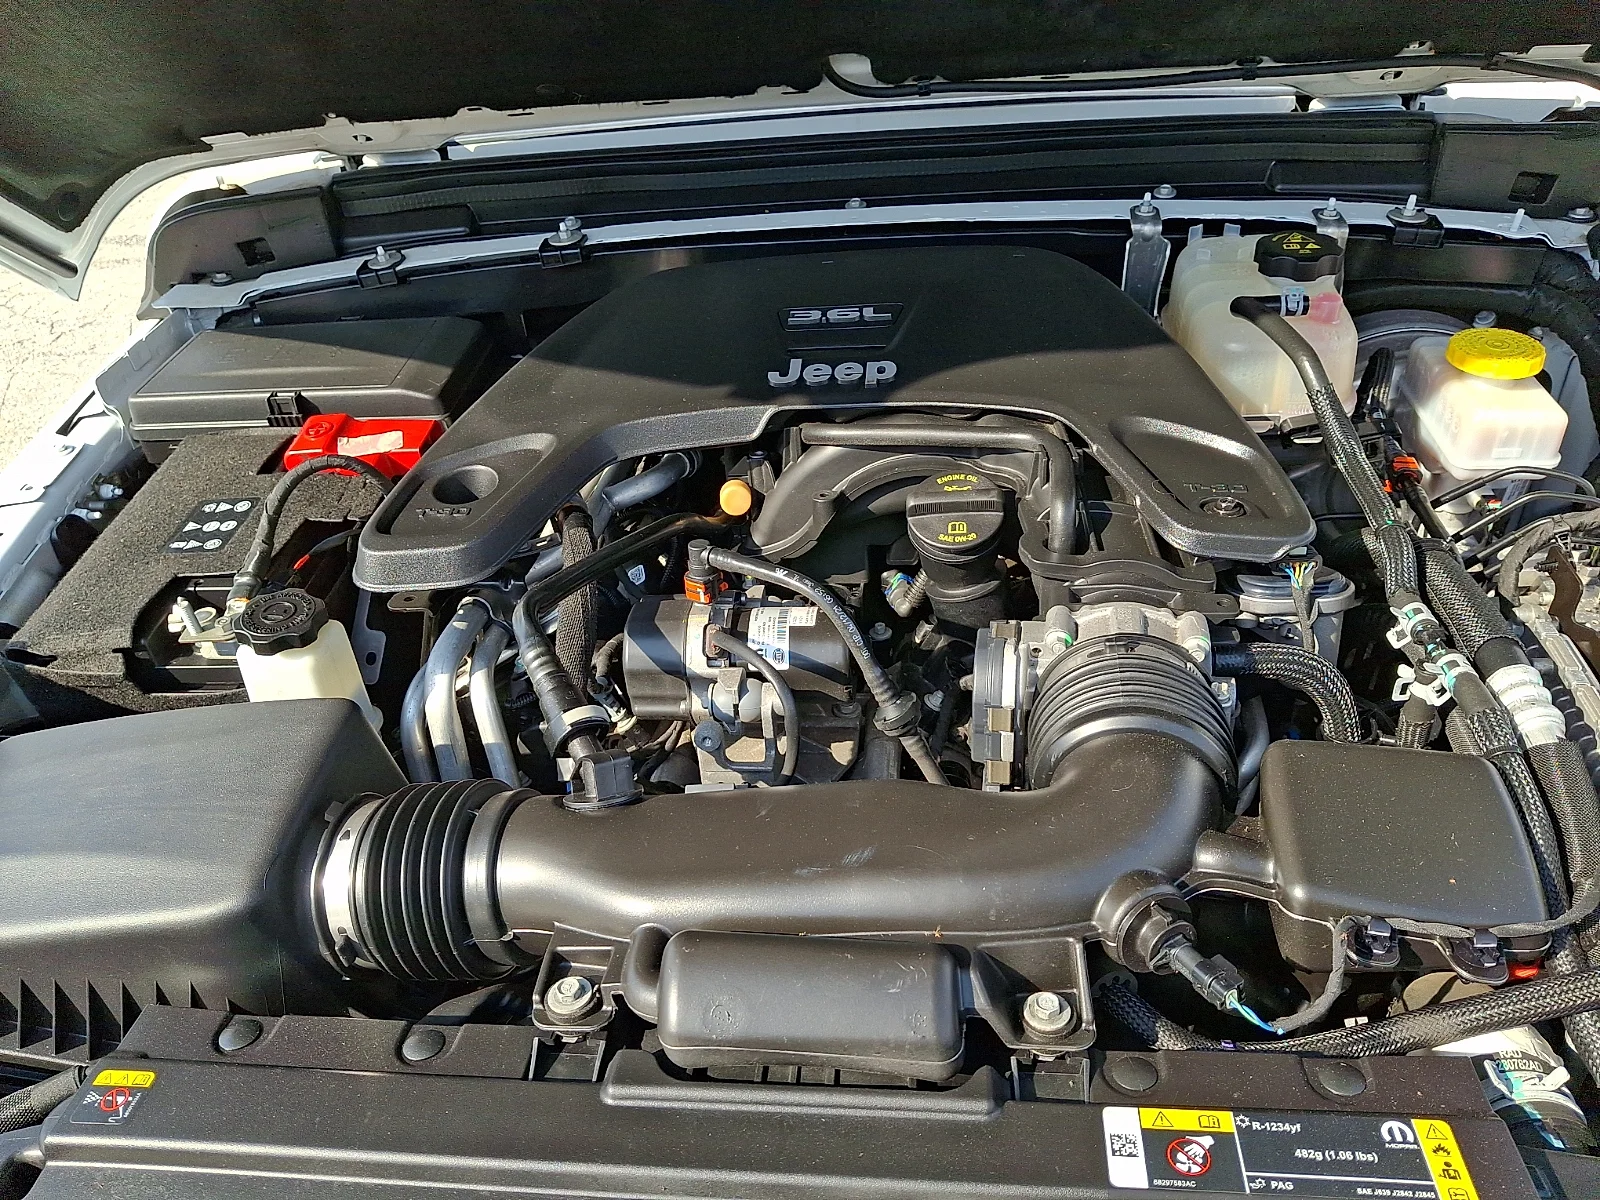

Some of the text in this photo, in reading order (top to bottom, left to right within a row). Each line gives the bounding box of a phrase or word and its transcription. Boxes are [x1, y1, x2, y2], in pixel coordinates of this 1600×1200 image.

[787, 307, 892, 325] 3.6L
[767, 358, 898, 388] Jeep
[936, 473, 979, 485] ENGINE OIL
[937, 533, 954, 542] SAE
[1251, 1121, 1301, 1134] R-1234yf
[1294, 1148, 1379, 1164] 482g (1.06 lbs)
[1270, 1180, 1294, 1190] PAG
[1357, 1187, 1373, 1195] SAE
